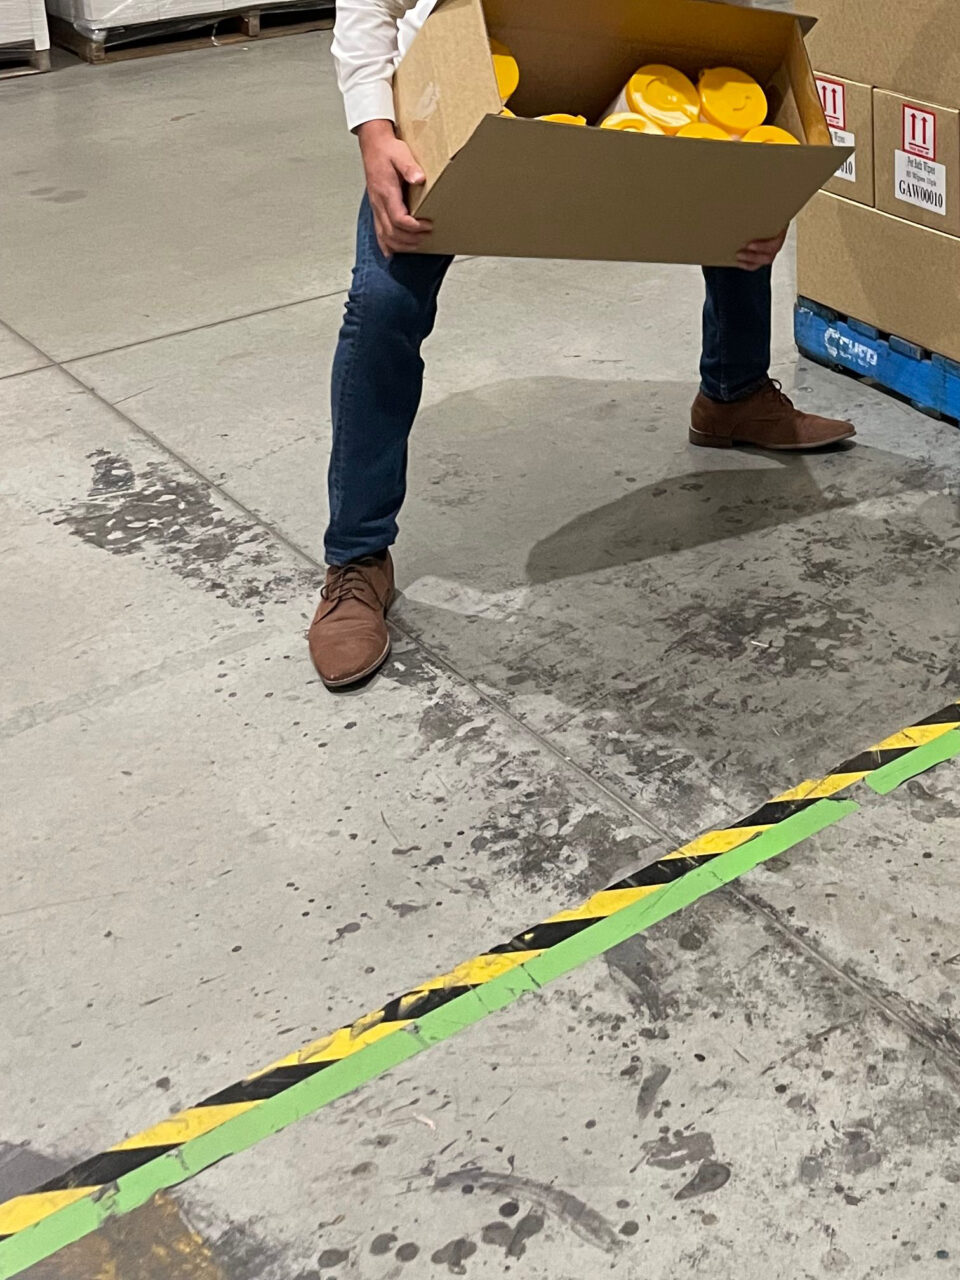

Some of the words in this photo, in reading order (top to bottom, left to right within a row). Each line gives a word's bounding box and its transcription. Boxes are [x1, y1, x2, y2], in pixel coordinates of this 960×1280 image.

[914, 158, 922, 170] Bath
[923, 161, 935, 175] Wipes
[899, 180, 943, 208] GAW00010
